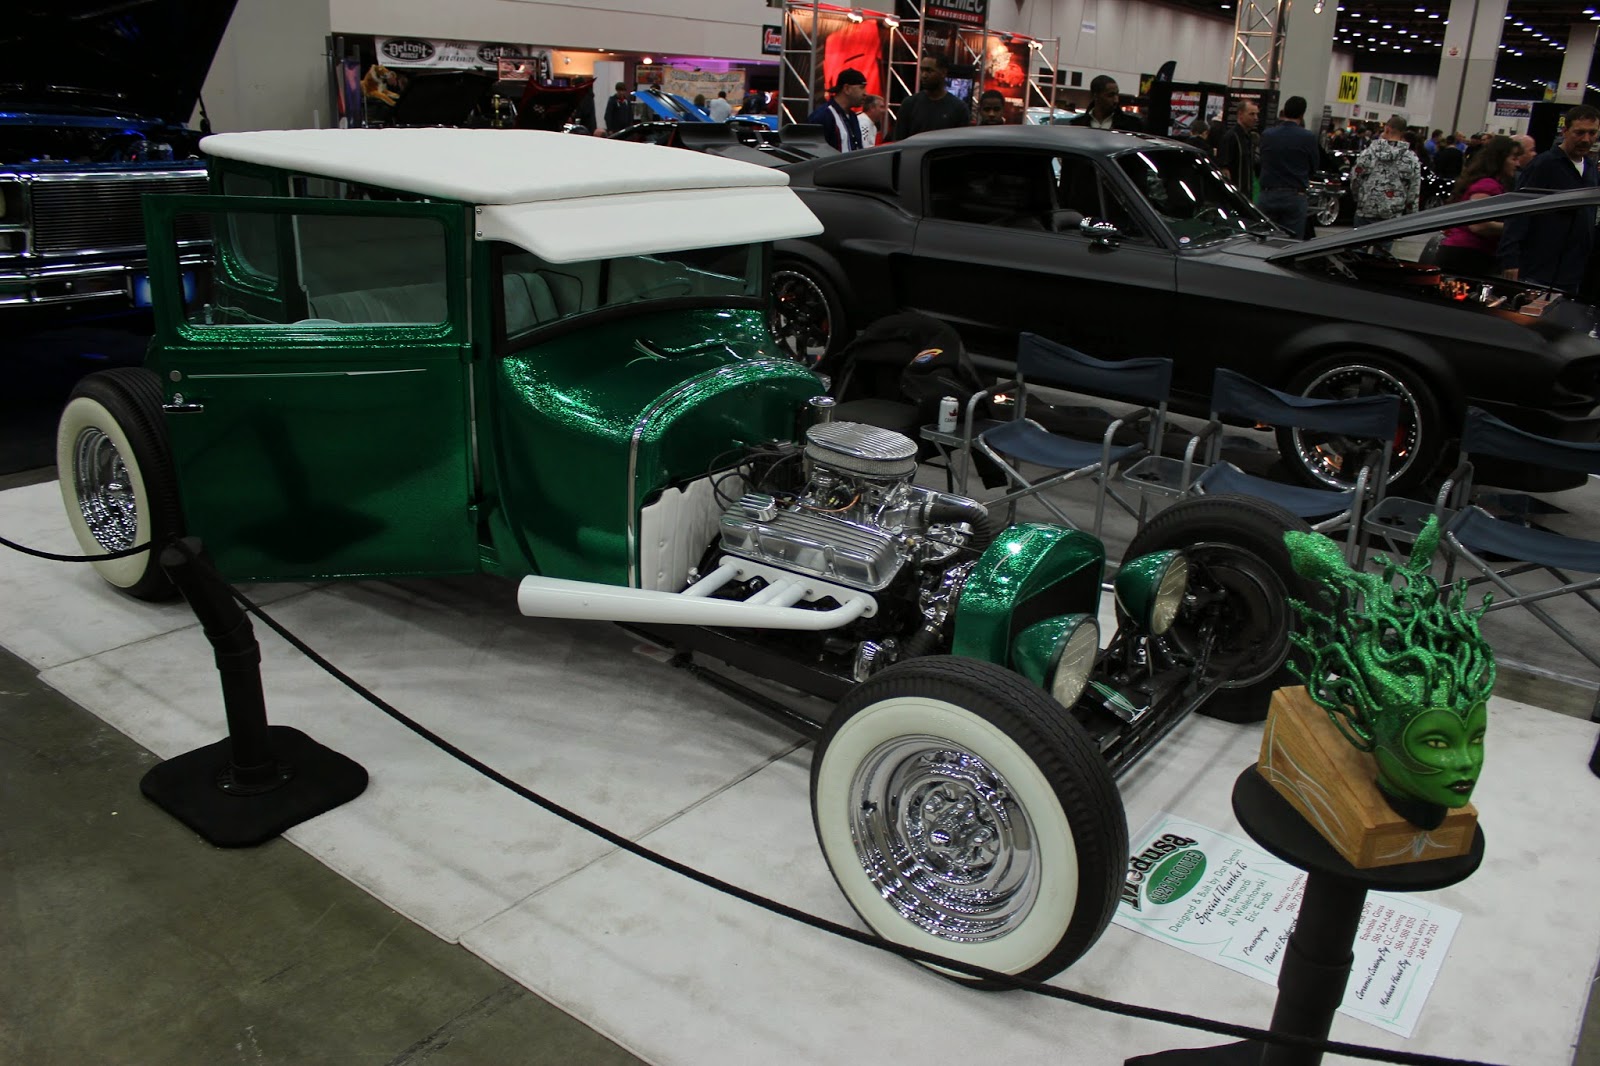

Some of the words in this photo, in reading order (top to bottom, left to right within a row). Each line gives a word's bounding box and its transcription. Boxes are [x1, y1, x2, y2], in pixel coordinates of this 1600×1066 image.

[934, 9, 979, 22] TRANSMISSIONS
[389, 42, 428, 57] Detroit
[1338, 75, 1358, 100] INFO
[1223, 849, 1243, 865] Dennis
[1120, 833, 1199, 912] Medusa
[1150, 882, 1176, 904] 1926
[1163, 850, 1205, 886] T-COUPE
[1214, 864, 1229, 877] Dan
[1199, 883, 1212, 898] Built
[1210, 877, 1220, 887] by
[1286, 873, 1305, 893] Graphics
[1191, 898, 1202, 906] &
[1194, 892, 1221, 926] Special
[1215, 871, 1243, 897] Thanks
[1235, 859, 1248, 870] To
[1217, 902, 1233, 918] Bert
[1227, 878, 1252, 904] Bernardi
[1169, 904, 1197, 933] Designed
[1227, 915, 1238, 927] Al
[1244, 909, 1260, 923] Eric
[1359, 918, 1377, 941] Equitable
[1371, 905, 1385, 918] Glass
[1242, 926, 1270, 957] Pinstriping
[1377, 946, 1391, 957] By
[1390, 914, 1407, 933] Coating
[1404, 932, 1420, 958] Layback
[1264, 945, 1280, 966] Paint
[1398, 959, 1412, 970] By
[1390, 965, 1404, 985] Head
[1379, 984, 1396, 1009] Medusa
